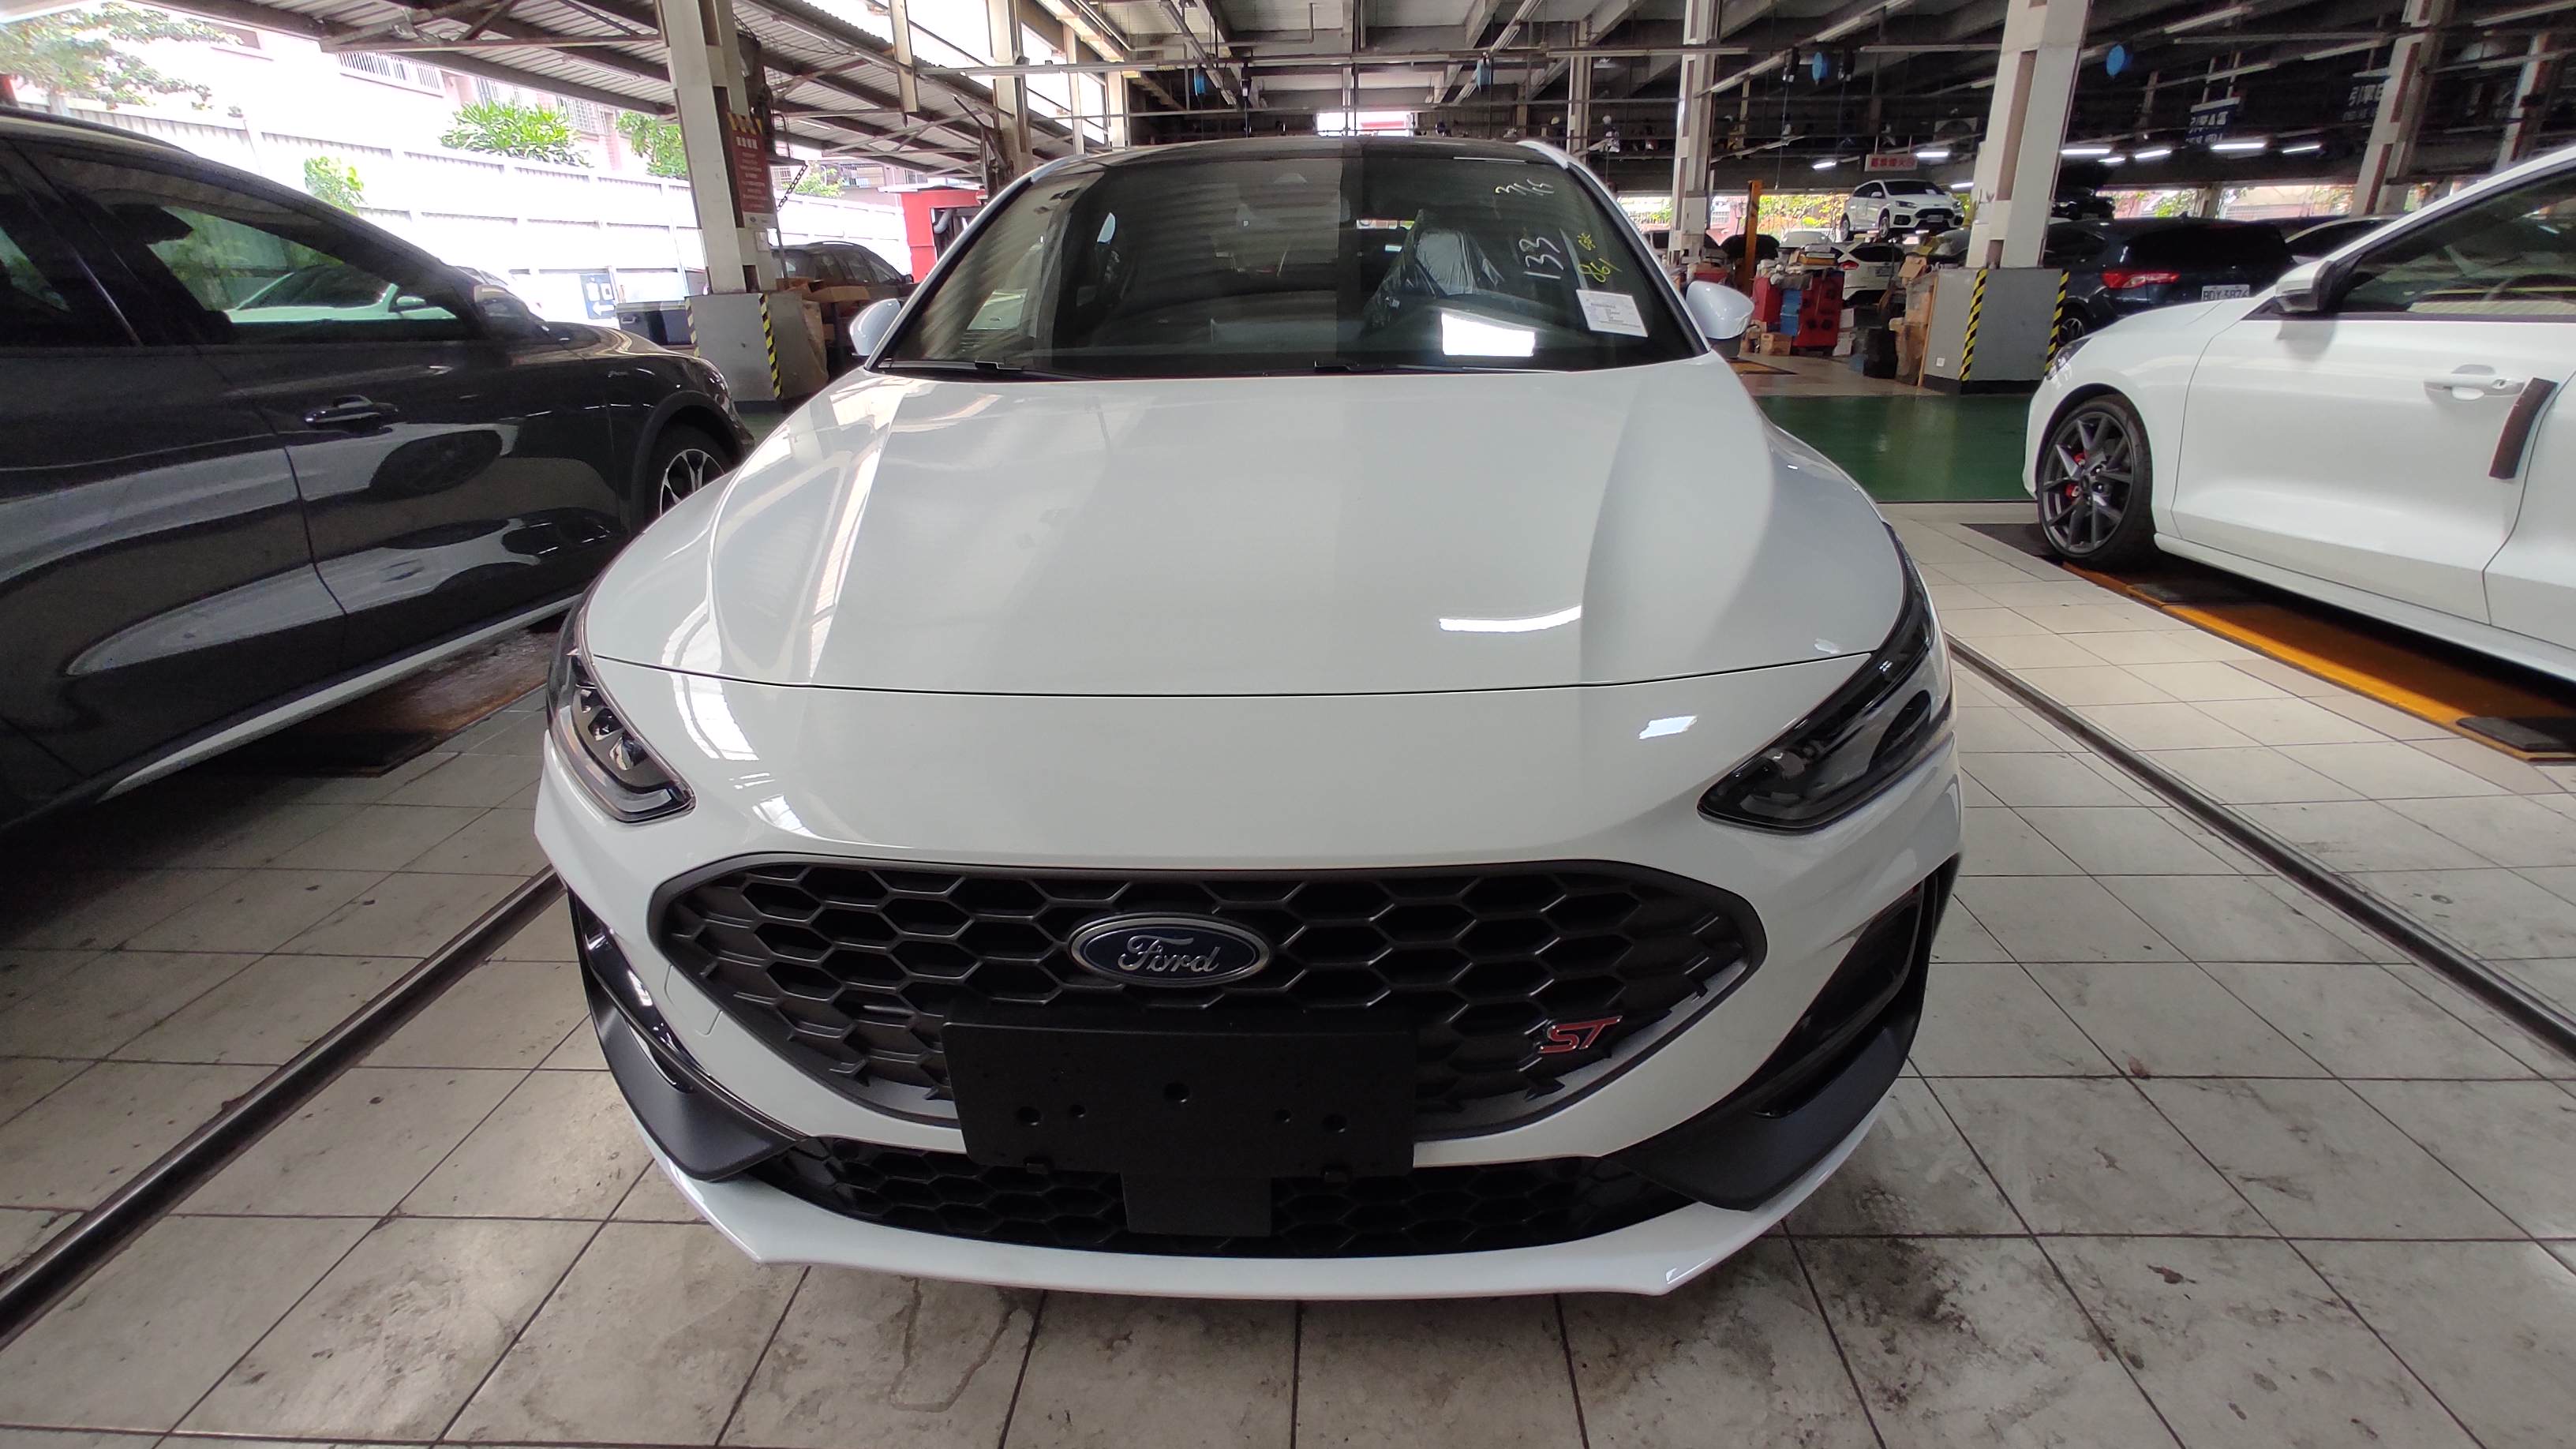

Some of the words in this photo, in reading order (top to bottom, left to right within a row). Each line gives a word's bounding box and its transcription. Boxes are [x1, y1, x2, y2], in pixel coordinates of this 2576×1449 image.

[1518, 235, 1564, 279] 133
[1577, 257, 1622, 283] 861
[1118, 934, 1220, 973] Ford
[1537, 1015, 1623, 1054] ST
